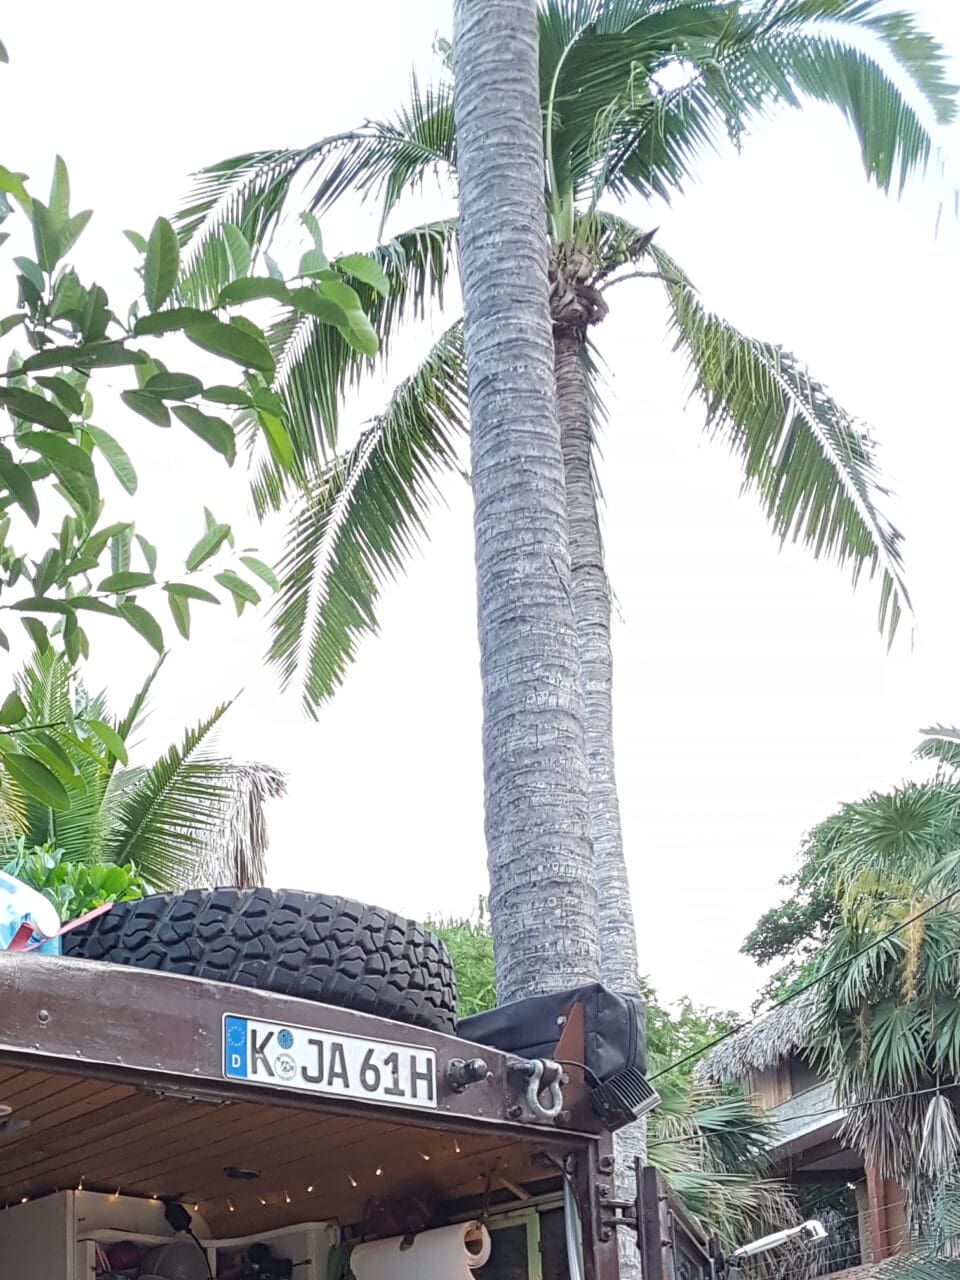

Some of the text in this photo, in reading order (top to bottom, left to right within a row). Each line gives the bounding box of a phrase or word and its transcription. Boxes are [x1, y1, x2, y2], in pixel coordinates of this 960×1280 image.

[231, 1053, 241, 1068] D
[300, 1038, 350, 1089] JA
[359, 1048, 434, 1101] 61H
